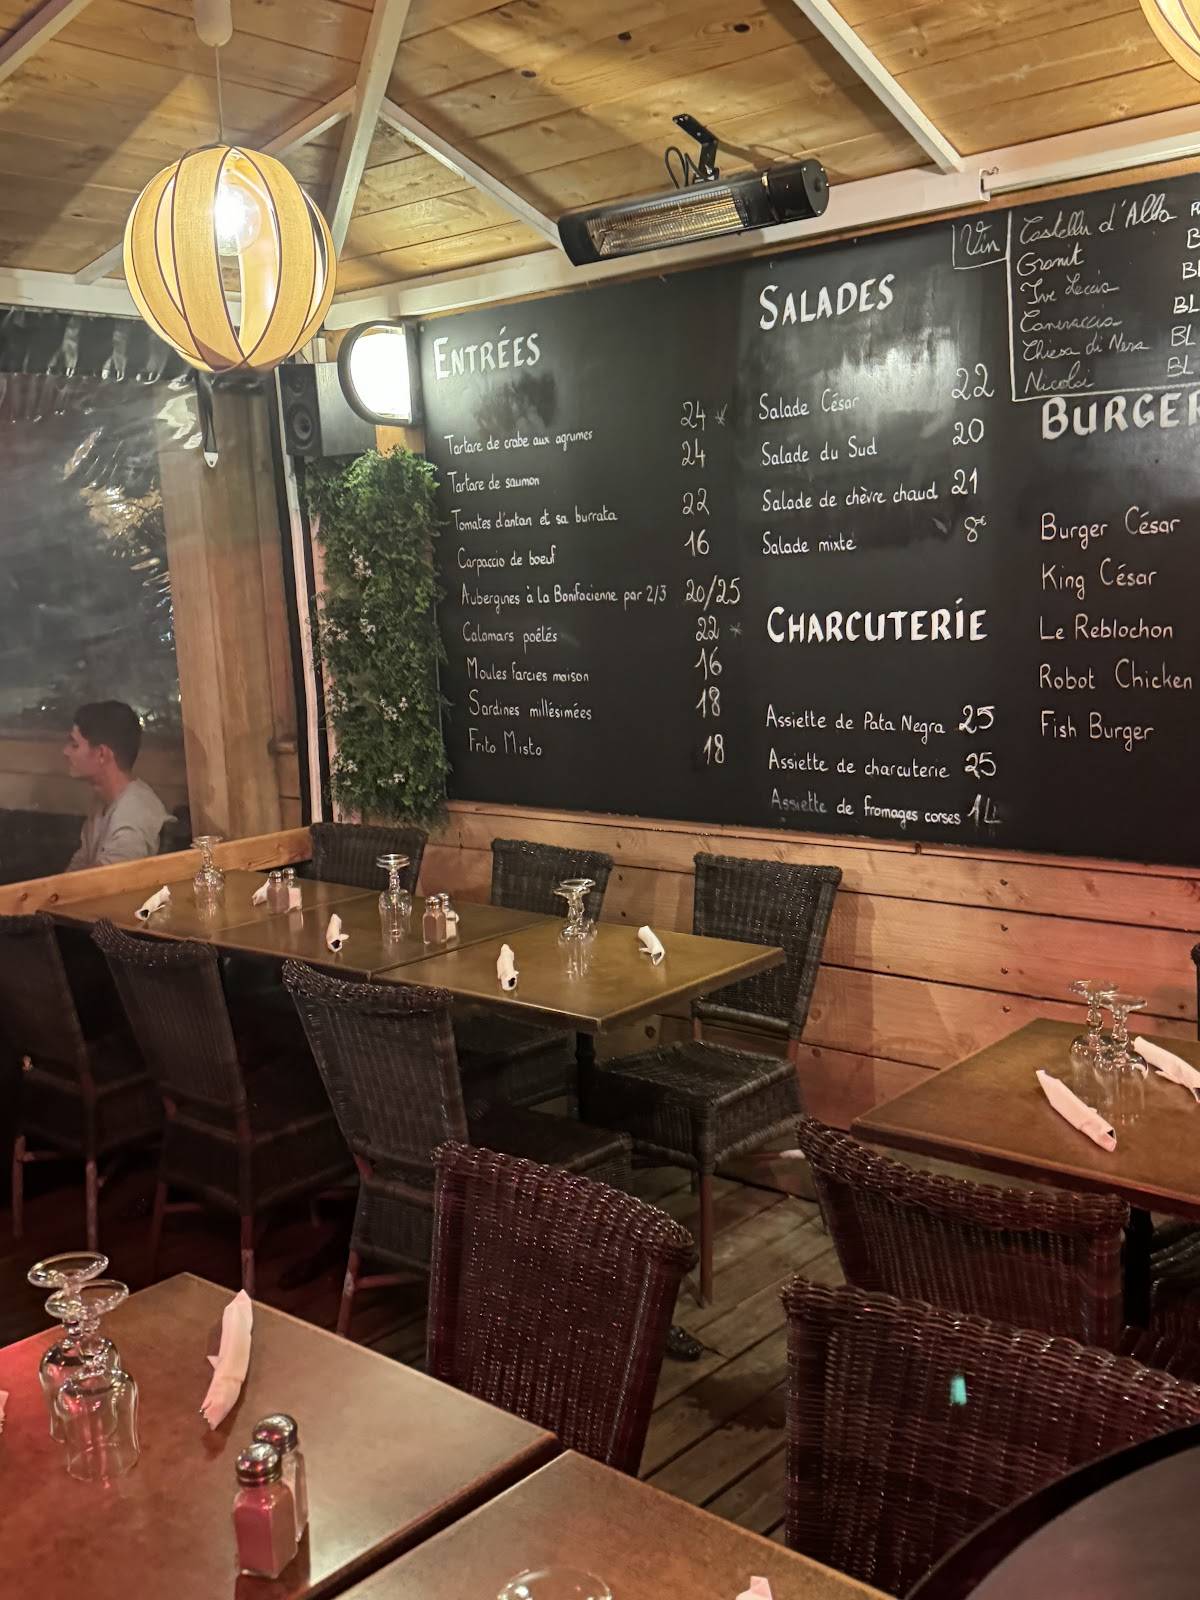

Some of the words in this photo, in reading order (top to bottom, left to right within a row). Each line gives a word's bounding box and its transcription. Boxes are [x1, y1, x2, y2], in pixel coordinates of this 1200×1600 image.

[759, 273, 895, 331] SALADES
[1173, 294, 1200, 314] BL
[433, 326, 541, 381] ENTRÉES
[1171, 324, 1196, 346] BL
[1167, 355, 1194, 377] BL
[759, 392, 810, 421] Salade
[821, 388, 860, 412] César
[951, 363, 994, 400] 22
[444, 434, 483, 456] Tartare
[486, 432, 500, 451] de
[504, 430, 530, 449] crabe
[533, 434, 550, 446] aux
[556, 430, 593, 452] agrumes
[680, 400, 706, 431] 24
[761, 441, 809, 466] Salade
[820, 441, 838, 461] du
[849, 435, 877, 458] Sud
[952, 418, 984, 445] 20
[447, 471, 485, 495] Tartare
[488, 472, 500, 491] de
[505, 476, 540, 488] saumon
[681, 438, 706, 468] 24
[761, 489, 812, 512] Salade
[819, 490, 837, 508] de
[846, 484, 886, 506] chèvre
[893, 481, 938, 503] chaud
[951, 467, 978, 495] 21
[451, 509, 491, 532] Tomates
[495, 511, 532, 529] d'antan
[540, 508, 551, 526] et
[556, 513, 568, 525] sa
[575, 505, 618, 523] burrata
[682, 488, 710, 516] 22
[1041, 512, 1108, 550] Burger
[1125, 505, 1181, 535] César
[458, 547, 505, 576] Carpaccio
[510, 551, 523, 566] de
[684, 529, 710, 557] 16
[762, 531, 810, 555] Salade
[819, 533, 856, 552] mixte
[461, 583, 520, 614] Aubergines
[526, 585, 534, 603] à
[537, 587, 550, 603] la
[554, 583, 618, 603] Bonifacienne
[623, 591, 643, 610] par
[646, 585, 667, 604] 2/3
[684, 574, 741, 611] 20/25
[1042, 563, 1085, 600] King
[1100, 558, 1157, 586] César
[462, 621, 514, 643] Calamars
[523, 626, 558, 654] poêlés
[695, 615, 720, 641] 22
[1040, 616, 1064, 640] Le
[1075, 613, 1173, 639] Reblochon
[466, 656, 507, 681] Moules
[511, 660, 547, 682] farcies
[552, 670, 589, 682] maison
[694, 646, 723, 681] 16
[1039, 663, 1095, 689] Robot
[1115, 658, 1192, 689] Chicken
[469, 689, 520, 717] Sardines
[529, 698, 592, 720] millésimées
[696, 686, 721, 718] 18
[766, 704, 827, 729] Assiette
[835, 713, 853, 730] de
[864, 711, 896, 732] Pata
[901, 715, 946, 744] Negra
[959, 704, 995, 734] 25
[1041, 710, 1077, 738] Fish
[1089, 711, 1154, 752] Burger
[468, 728, 496, 754] Frito
[503, 729, 542, 756] Misto
[703, 733, 725, 765] 18
[768, 747, 829, 772] Assiette
[837, 758, 856, 774] de
[864, 758, 950, 778] charcuterie
[965, 752, 996, 779] 25
[771, 788, 827, 813] Assiette
[836, 798, 854, 815] de
[864, 795, 918, 829] fromages
[925, 810, 961, 825] corses
